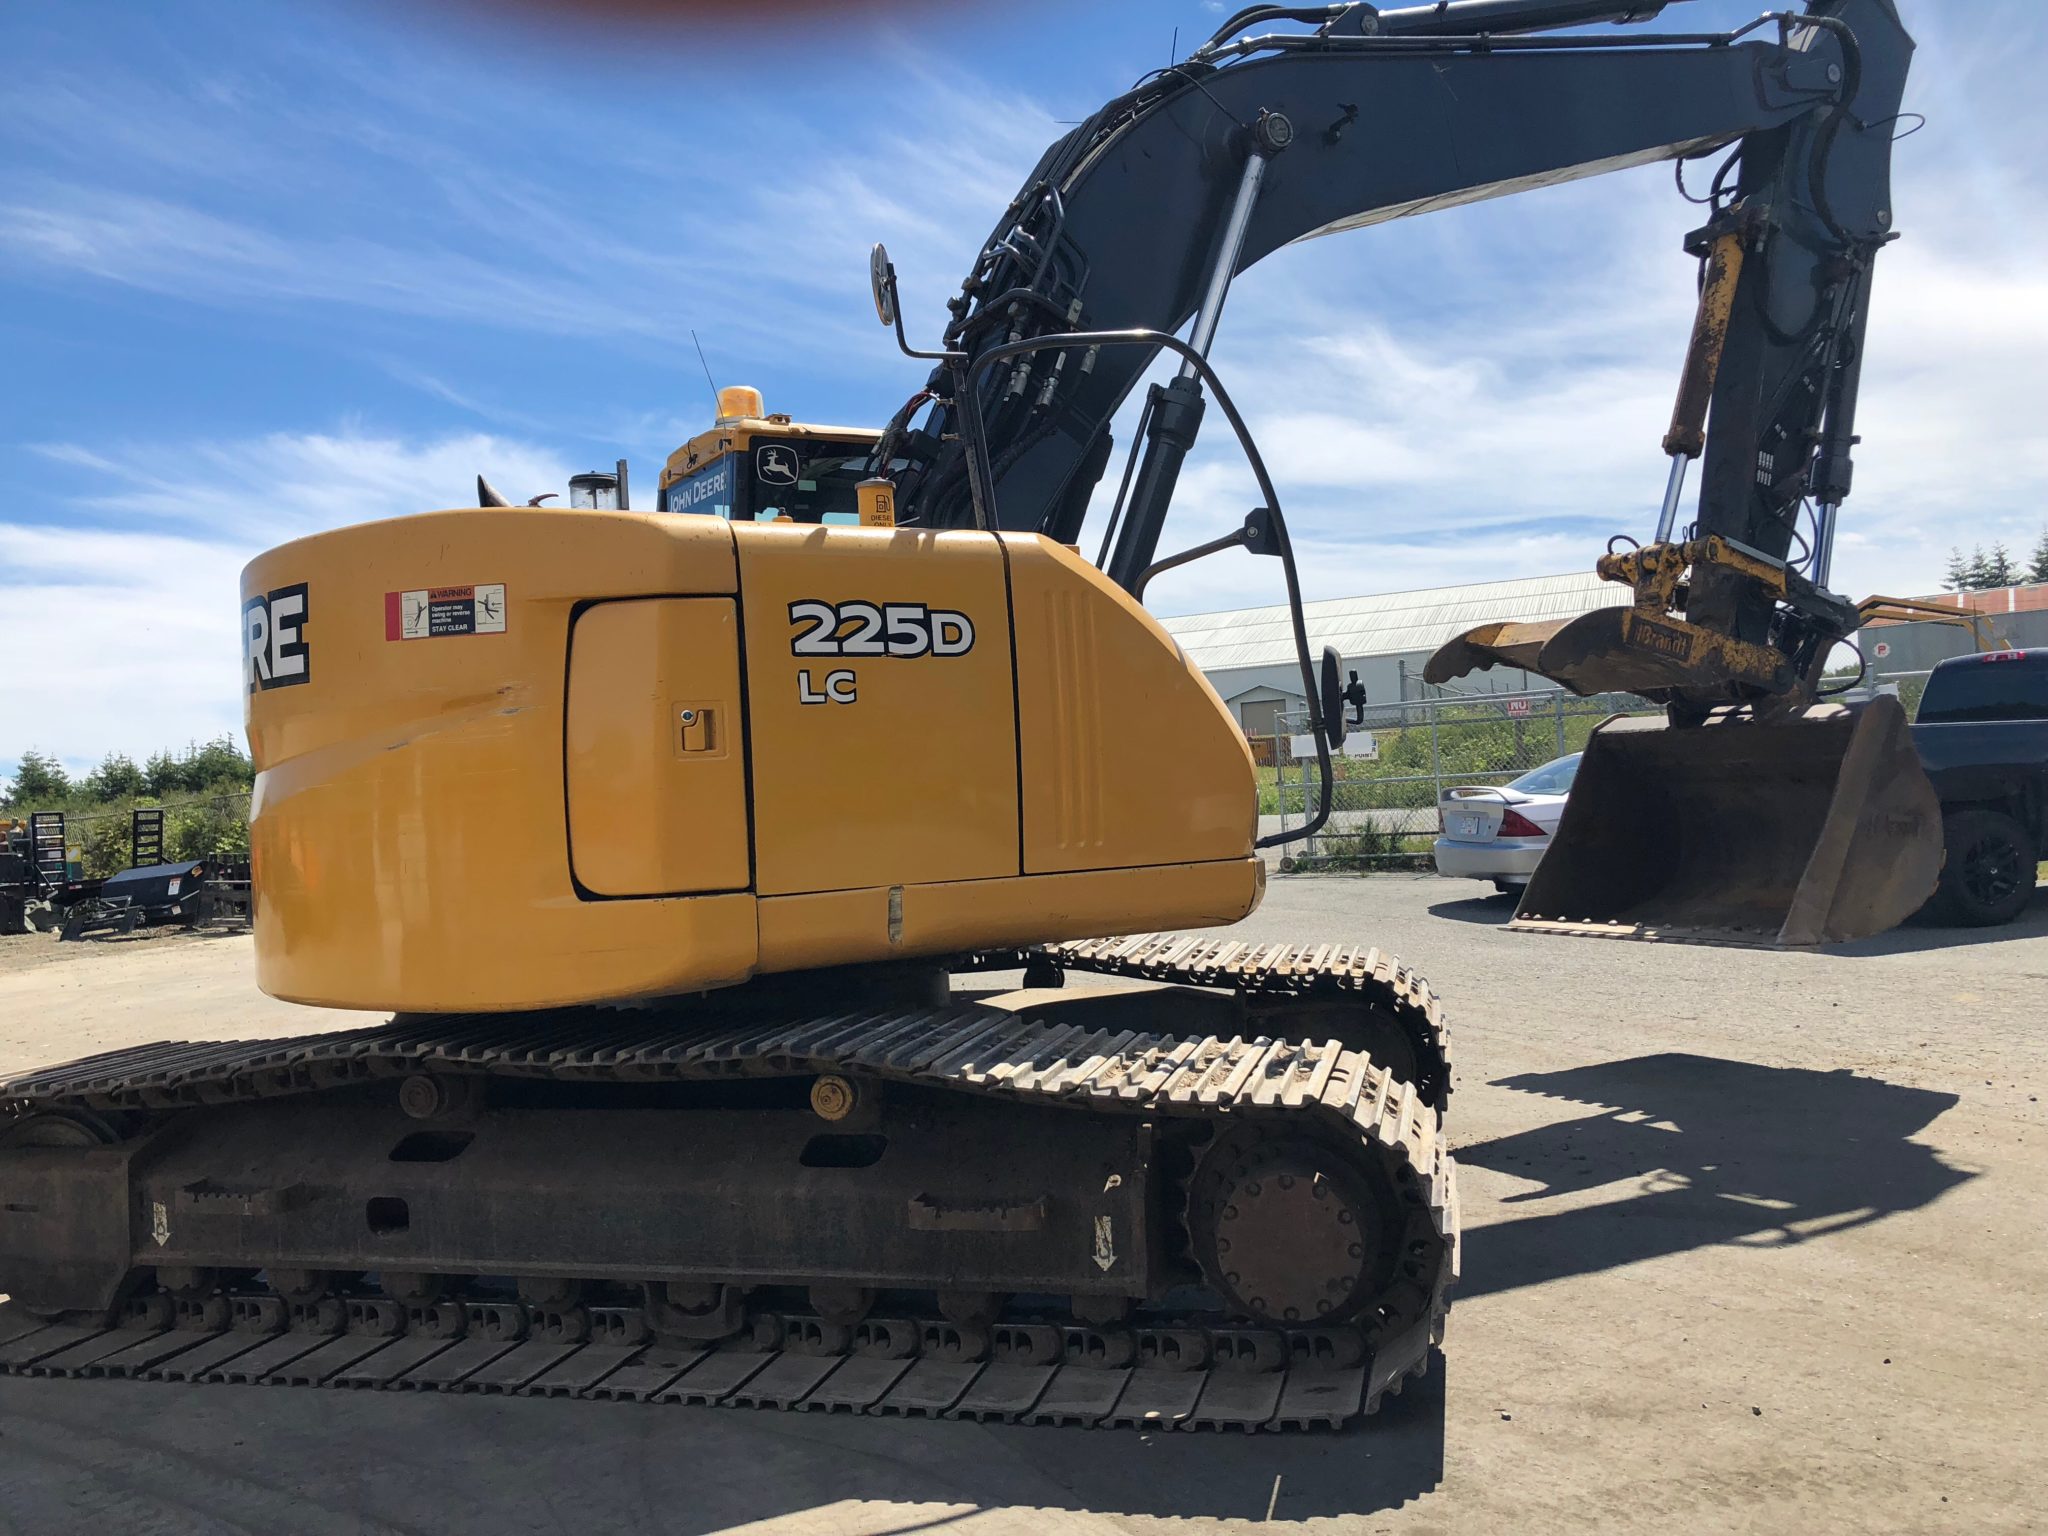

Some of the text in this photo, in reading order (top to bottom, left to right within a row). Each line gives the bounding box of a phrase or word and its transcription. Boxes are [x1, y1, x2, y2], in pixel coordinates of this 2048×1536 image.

[670, 470, 727, 512] JOHN DEERE
[870, 514, 893, 522] DIESEL
[436, 588, 472, 598] WARNING
[243, 589, 307, 687] RE
[789, 600, 974, 657] 225D
[798, 670, 856, 703] LC
